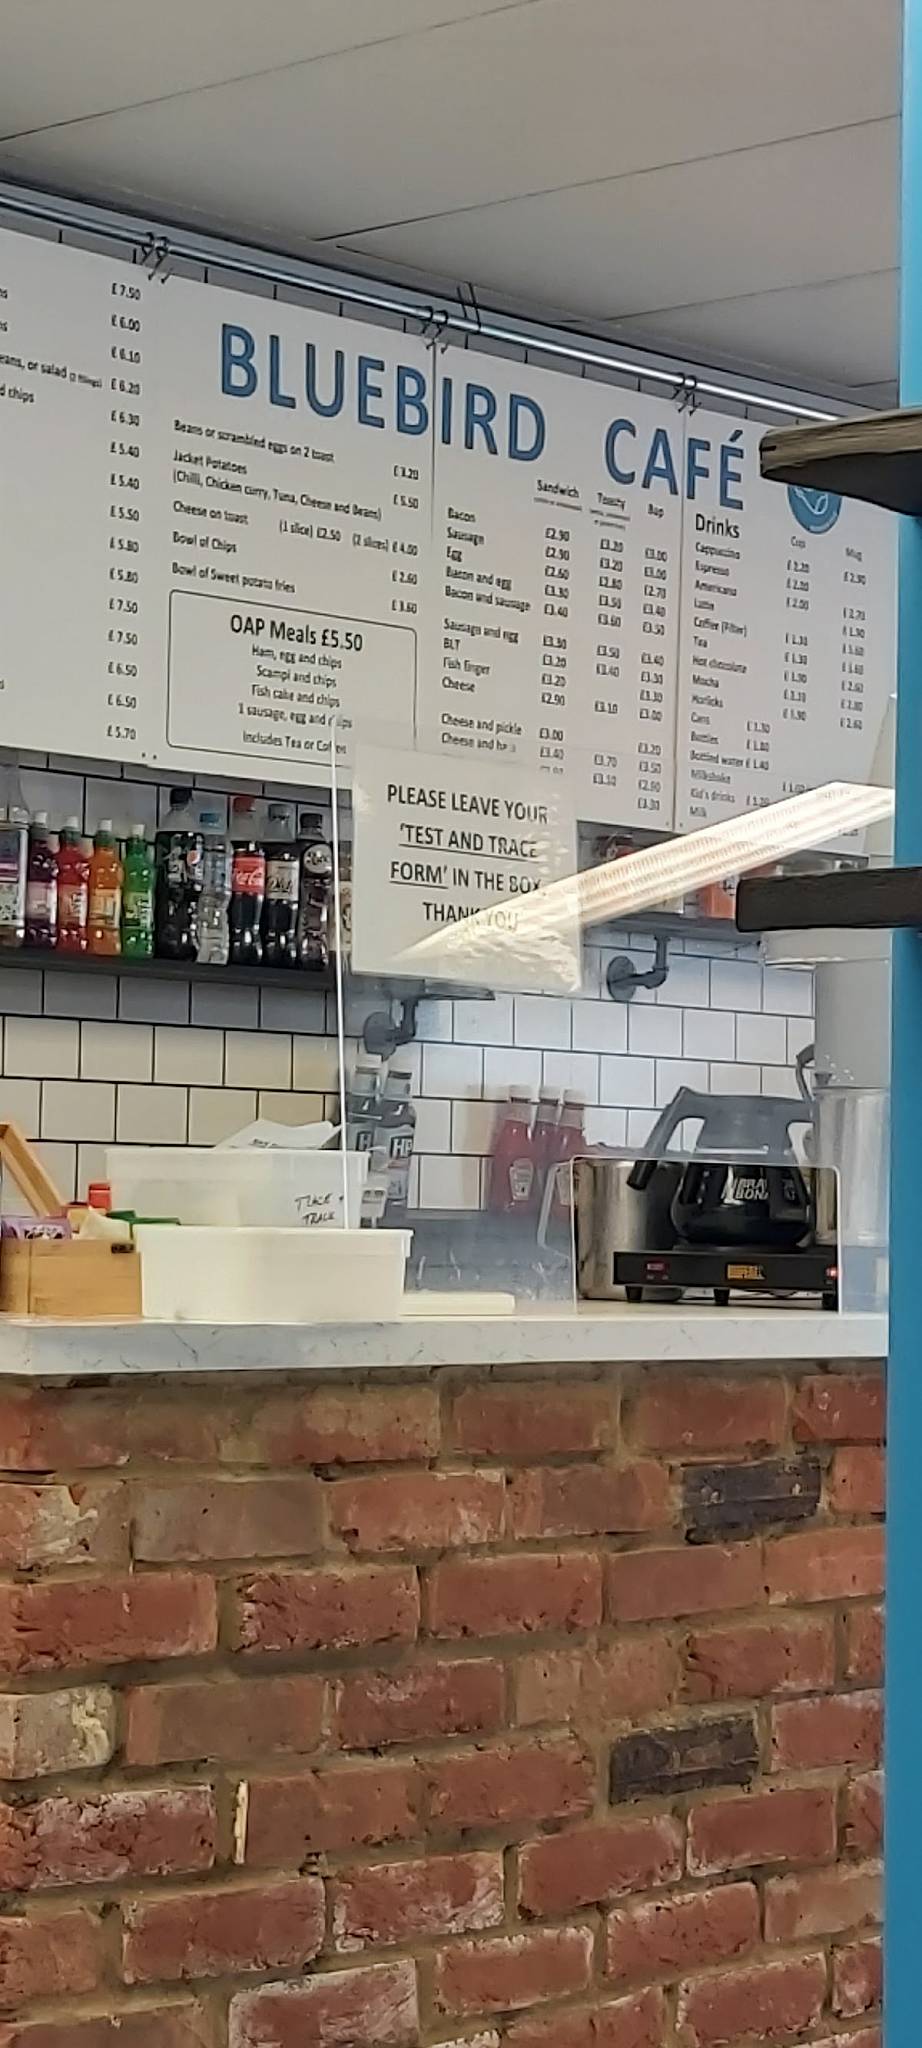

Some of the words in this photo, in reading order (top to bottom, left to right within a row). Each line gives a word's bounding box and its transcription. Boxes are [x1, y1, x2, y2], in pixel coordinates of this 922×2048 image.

[41, 362, 68, 379] salad
[220, 322, 547, 462] BLUEBIRD
[604, 417, 747, 511] CAFÉ
[174, 419, 203, 436] Beans
[205, 427, 216, 439] or
[217, 431, 266, 448] scrambled
[268, 440, 288, 455] eggs
[290, 445, 302, 456] on
[304, 446, 310, 458] 2
[311, 449, 336, 464] toast
[173, 449, 203, 467] Jacket
[206, 455, 248, 475] Potatoes
[206, 475, 242, 493] Chicken
[300, 494, 333, 511] Cheese
[335, 503, 351, 515] and
[536, 479, 580, 498] Sandwich
[597, 491, 627, 512] Toasty
[173, 500, 208, 517] Cheese
[209, 509, 222, 520] on
[224, 510, 249, 526] toast
[447, 506, 477, 523] Bacon
[446, 526, 485, 546] Sausage
[694, 512, 741, 539] Drinks
[172, 530, 197, 547] Bowl
[199, 536, 209, 549] of
[211, 538, 237, 554] Chips
[694, 541, 741, 560] Cappuccino
[446, 545, 463, 562] Egg
[172, 561, 197, 578] Bowl
[199, 566, 209, 579] of
[211, 567, 240, 585] Sweet
[242, 575, 273, 591] potato
[275, 578, 296, 594] fries
[446, 565, 474, 581] Bacon
[475, 573, 493, 586] and
[495, 577, 512, 592] egg
[694, 559, 730, 577] Espresso
[694, 579, 738, 597] Americano
[445, 584, 473, 602] Bacon
[475, 592, 493, 605] and
[494, 595, 531, 614] sausage
[230, 613, 265, 637] OAP
[269, 619, 317, 646] Meals
[320, 628, 364, 653] £5.50
[444, 617, 482, 637] Sausage
[483, 626, 501, 639] and
[502, 630, 519, 645] egg
[693, 616, 720, 631] Coffee
[443, 636, 461, 651] BLT
[692, 635, 708, 648] Tea
[251, 643, 278, 662] Ham,
[279, 650, 297, 665] egg
[298, 652, 316, 666] and
[318, 655, 343, 671] chips
[442, 656, 462, 671] Fish
[691, 654, 707, 667] Hot
[708, 657, 748, 674] chocolate
[256, 664, 291, 684] Scampi
[293, 671, 312, 685] and
[313, 673, 338, 690] chips
[441, 675, 476, 693] Cheese
[691, 673, 720, 689] Mocha
[251, 683, 271, 699] Fish
[272, 686, 295, 703] cake
[296, 692, 315, 706] and
[316, 693, 341, 709] chips
[238, 702, 245, 716] 1
[290, 710, 307, 726] egg
[308, 711, 326, 727] and
[440, 712, 475, 729] Cheese
[476, 719, 495, 732] and
[495, 722, 523, 737] pickle
[690, 711, 711, 726] Cans
[242, 729, 284, 748] Includes
[285, 735, 302, 751] Tea
[303, 739, 315, 751] or
[440, 731, 475, 749] Cheese
[476, 738, 495, 751] and
[690, 730, 719, 746] Bottles
[689, 749, 719, 765] Bottled
[720, 756, 744, 769] water
[386, 783, 447, 810] PLEASE
[451, 792, 500, 818] LEAVE
[504, 799, 549, 825] YOUR
[710, 789, 736, 804] drinks
[448, 830, 484, 852] AND
[488, 834, 542, 859] TRACE
[452, 868, 470, 888] IN
[474, 870, 505, 892] THE
